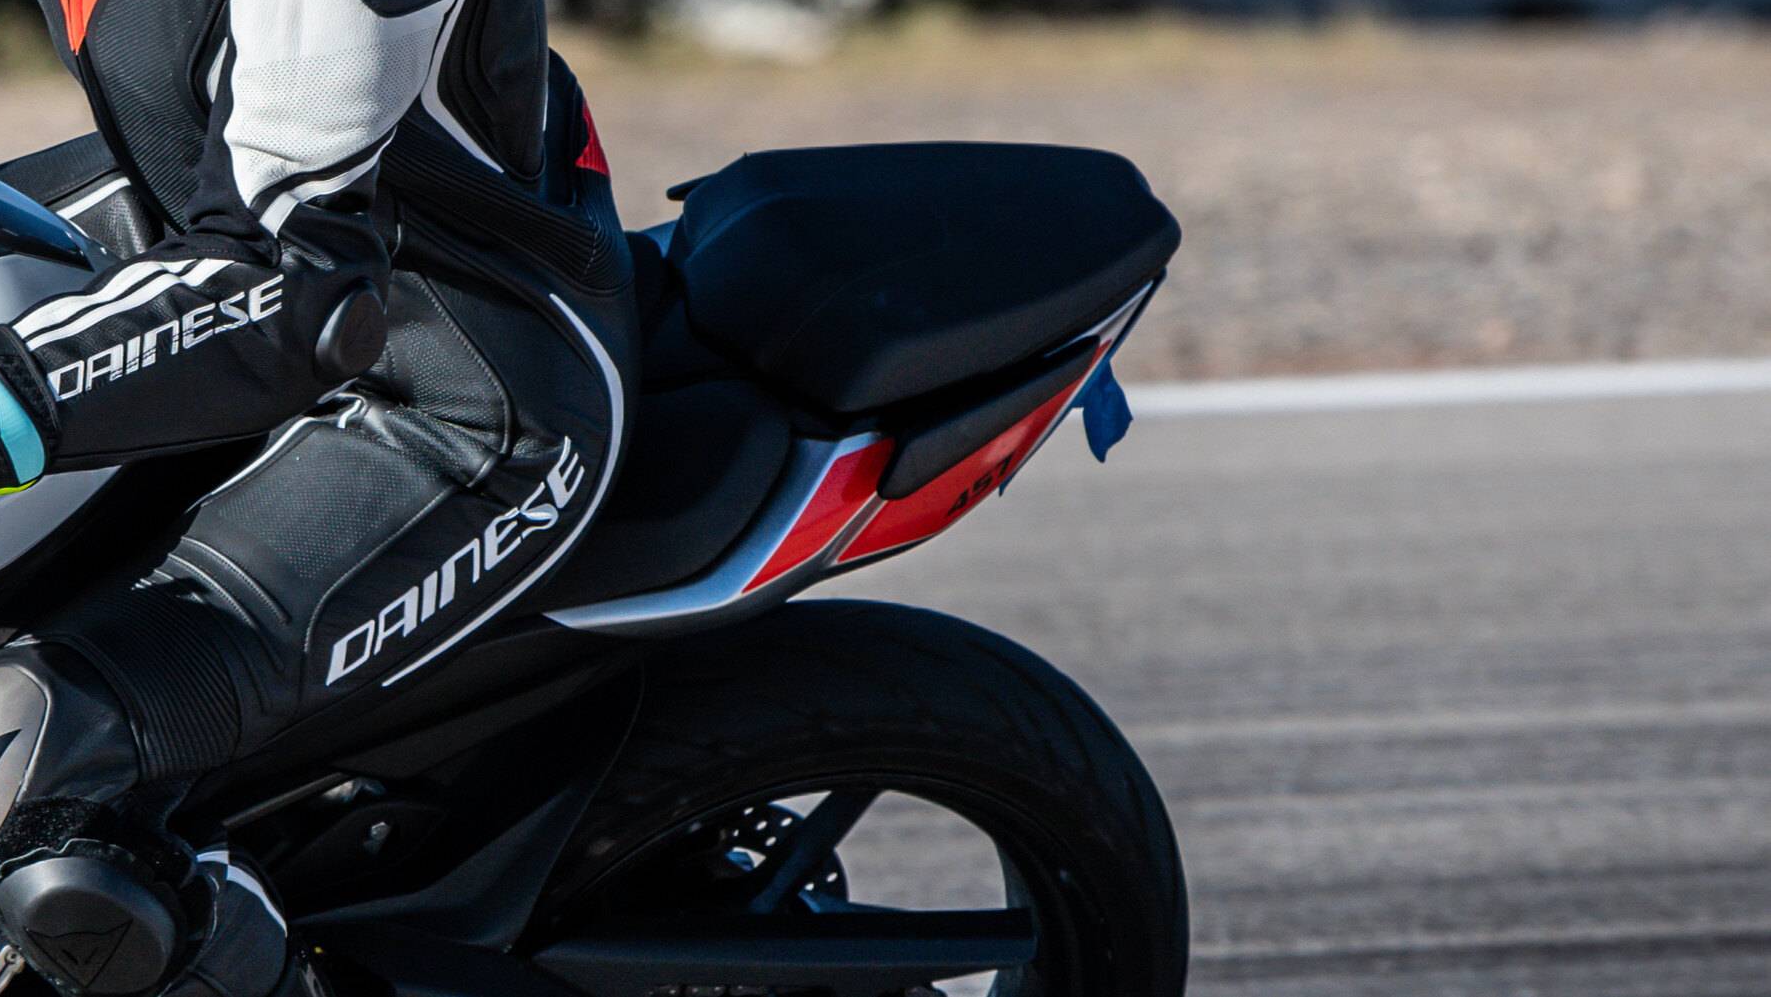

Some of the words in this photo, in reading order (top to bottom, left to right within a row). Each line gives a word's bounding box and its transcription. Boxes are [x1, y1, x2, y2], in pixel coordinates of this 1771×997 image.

[46, 273, 285, 403] DAINESE
[945, 451, 1015, 517] 457
[325, 436, 586, 688] DAINESE
